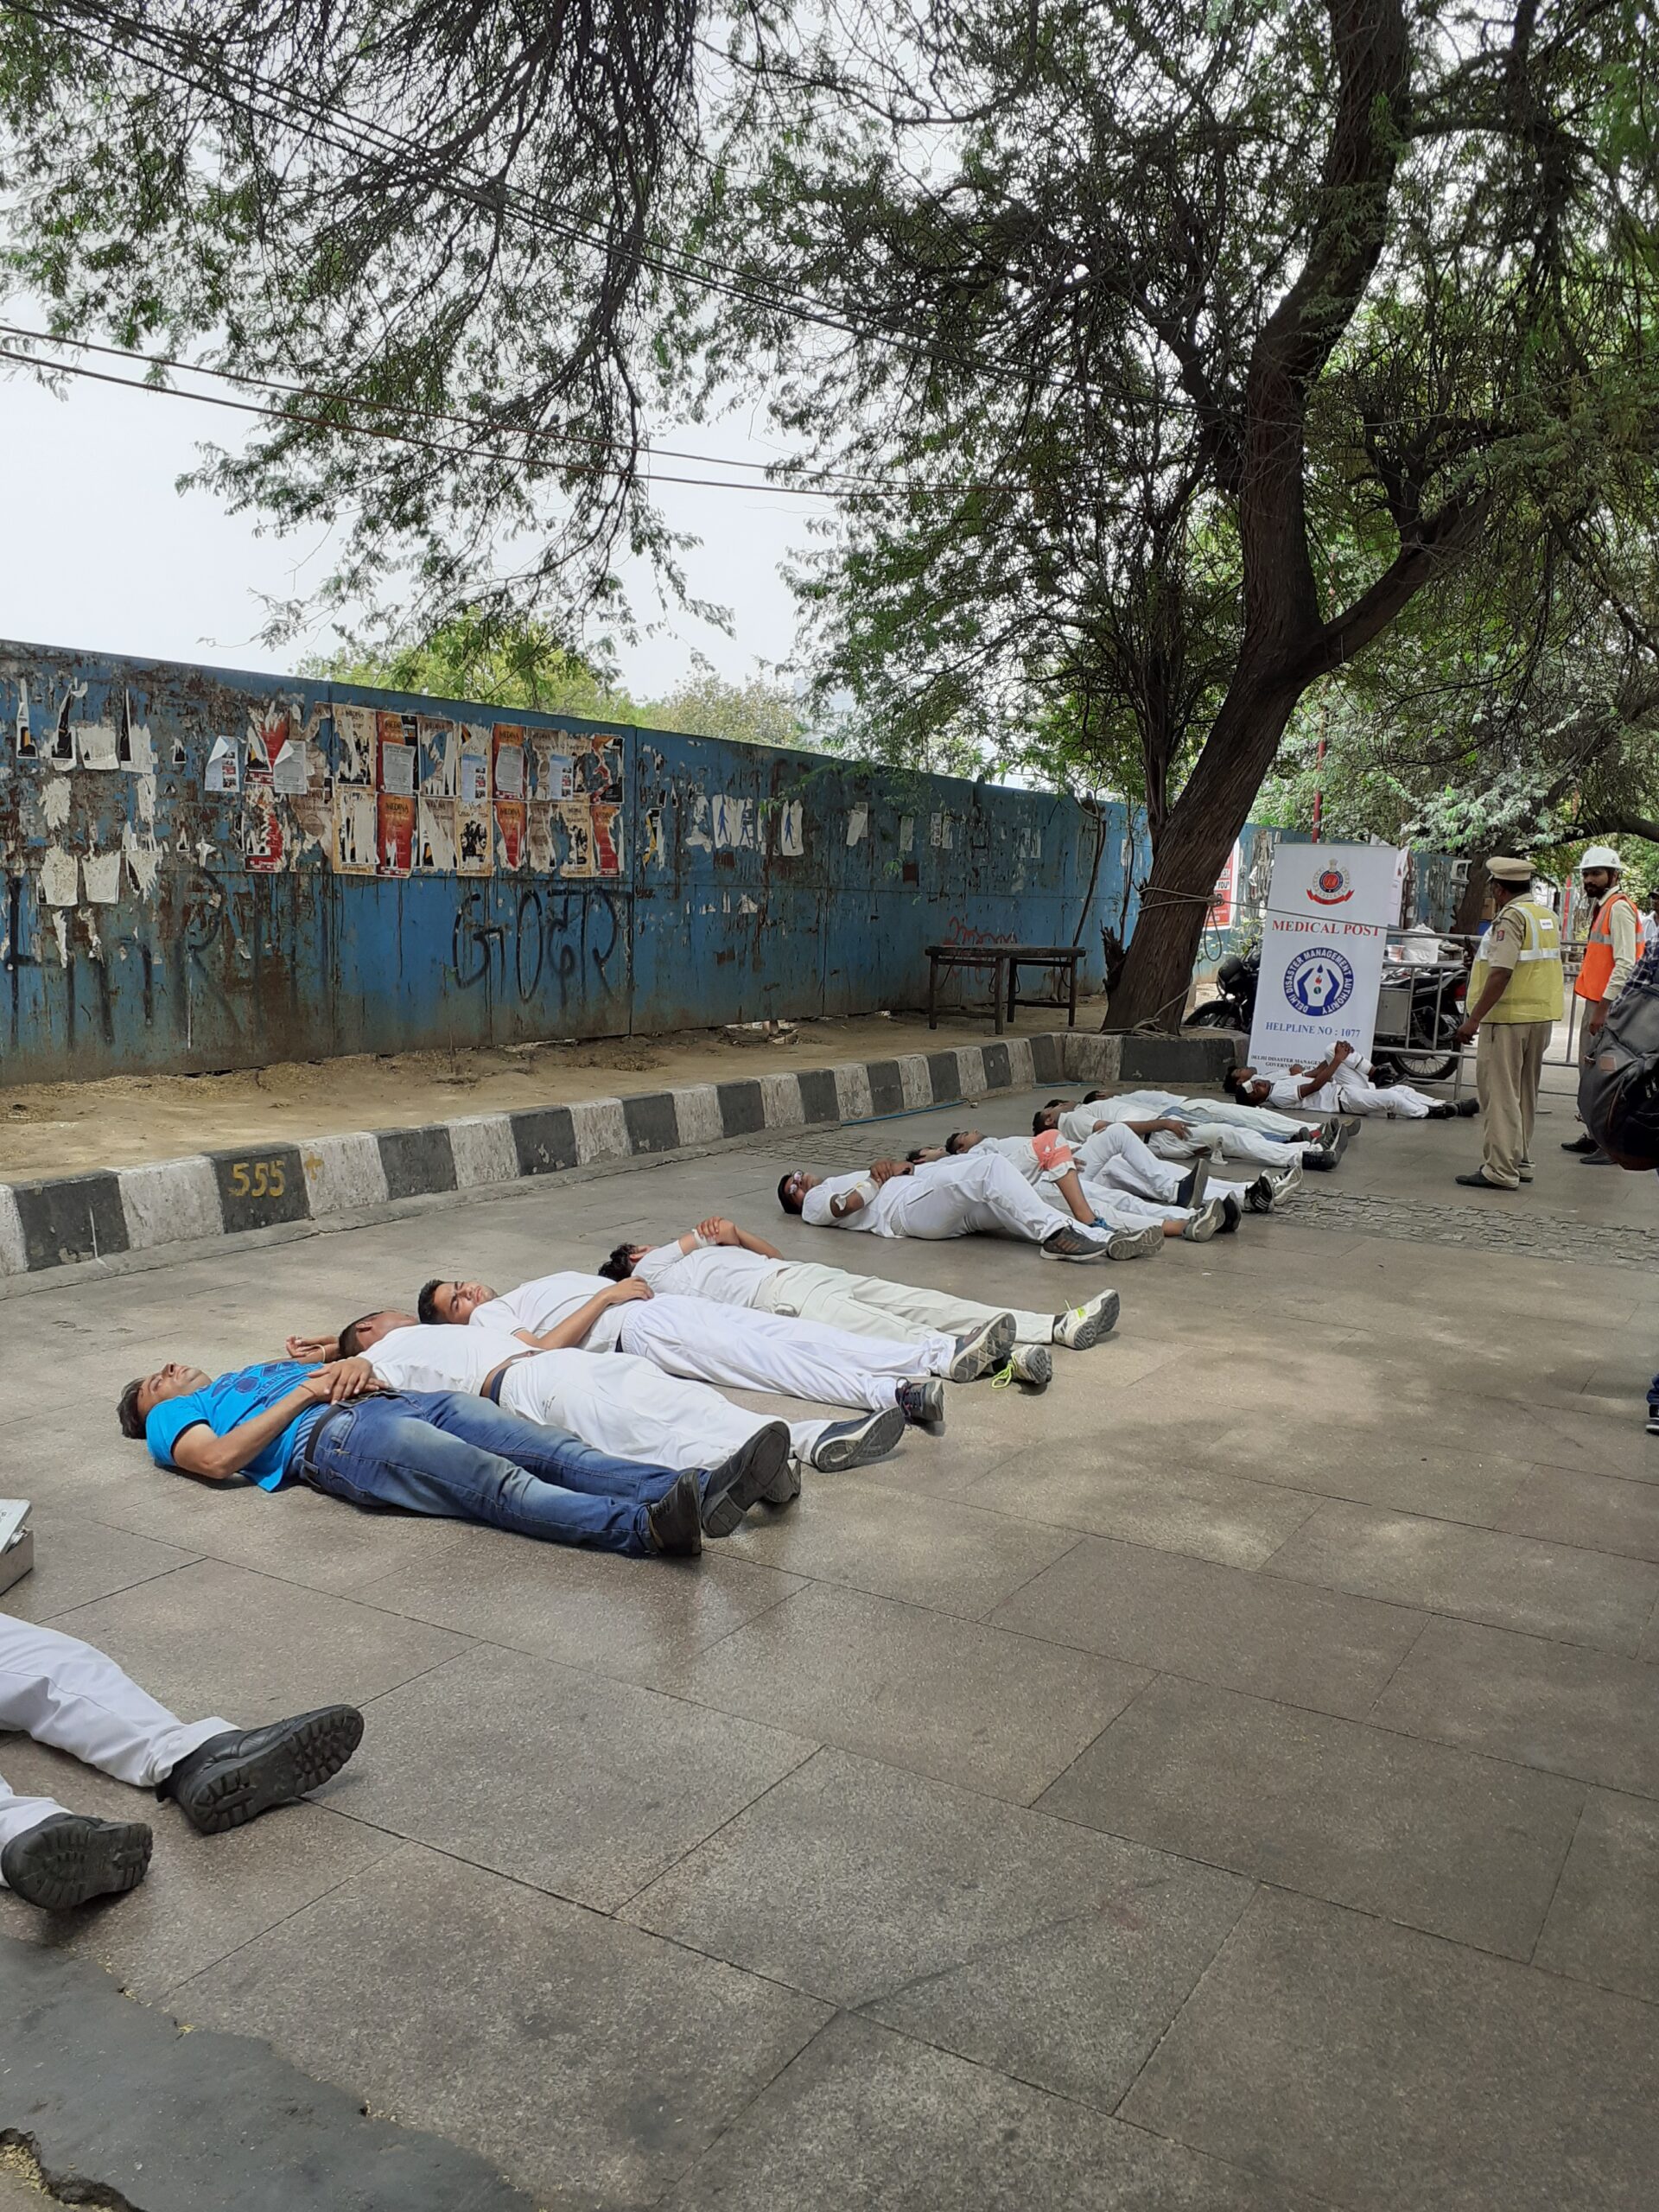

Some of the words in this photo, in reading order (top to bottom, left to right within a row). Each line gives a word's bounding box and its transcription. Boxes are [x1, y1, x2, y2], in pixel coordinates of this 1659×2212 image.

[1272, 920, 1339, 934] MEDICAL
[1344, 924, 1380, 937] POST
[1285, 957, 1304, 994] DISASTER
[1303, 949, 1352, 976] MANAGEMENT
[1288, 994, 1309, 1014] DELHI
[1322, 977, 1352, 1015] AUTHORITY
[1266, 1021, 1315, 1034] HELPLINE
[1318, 1026, 1332, 1035] NO
[1341, 1028, 1360, 1037] 1077
[228, 1160, 285, 1197] 555
